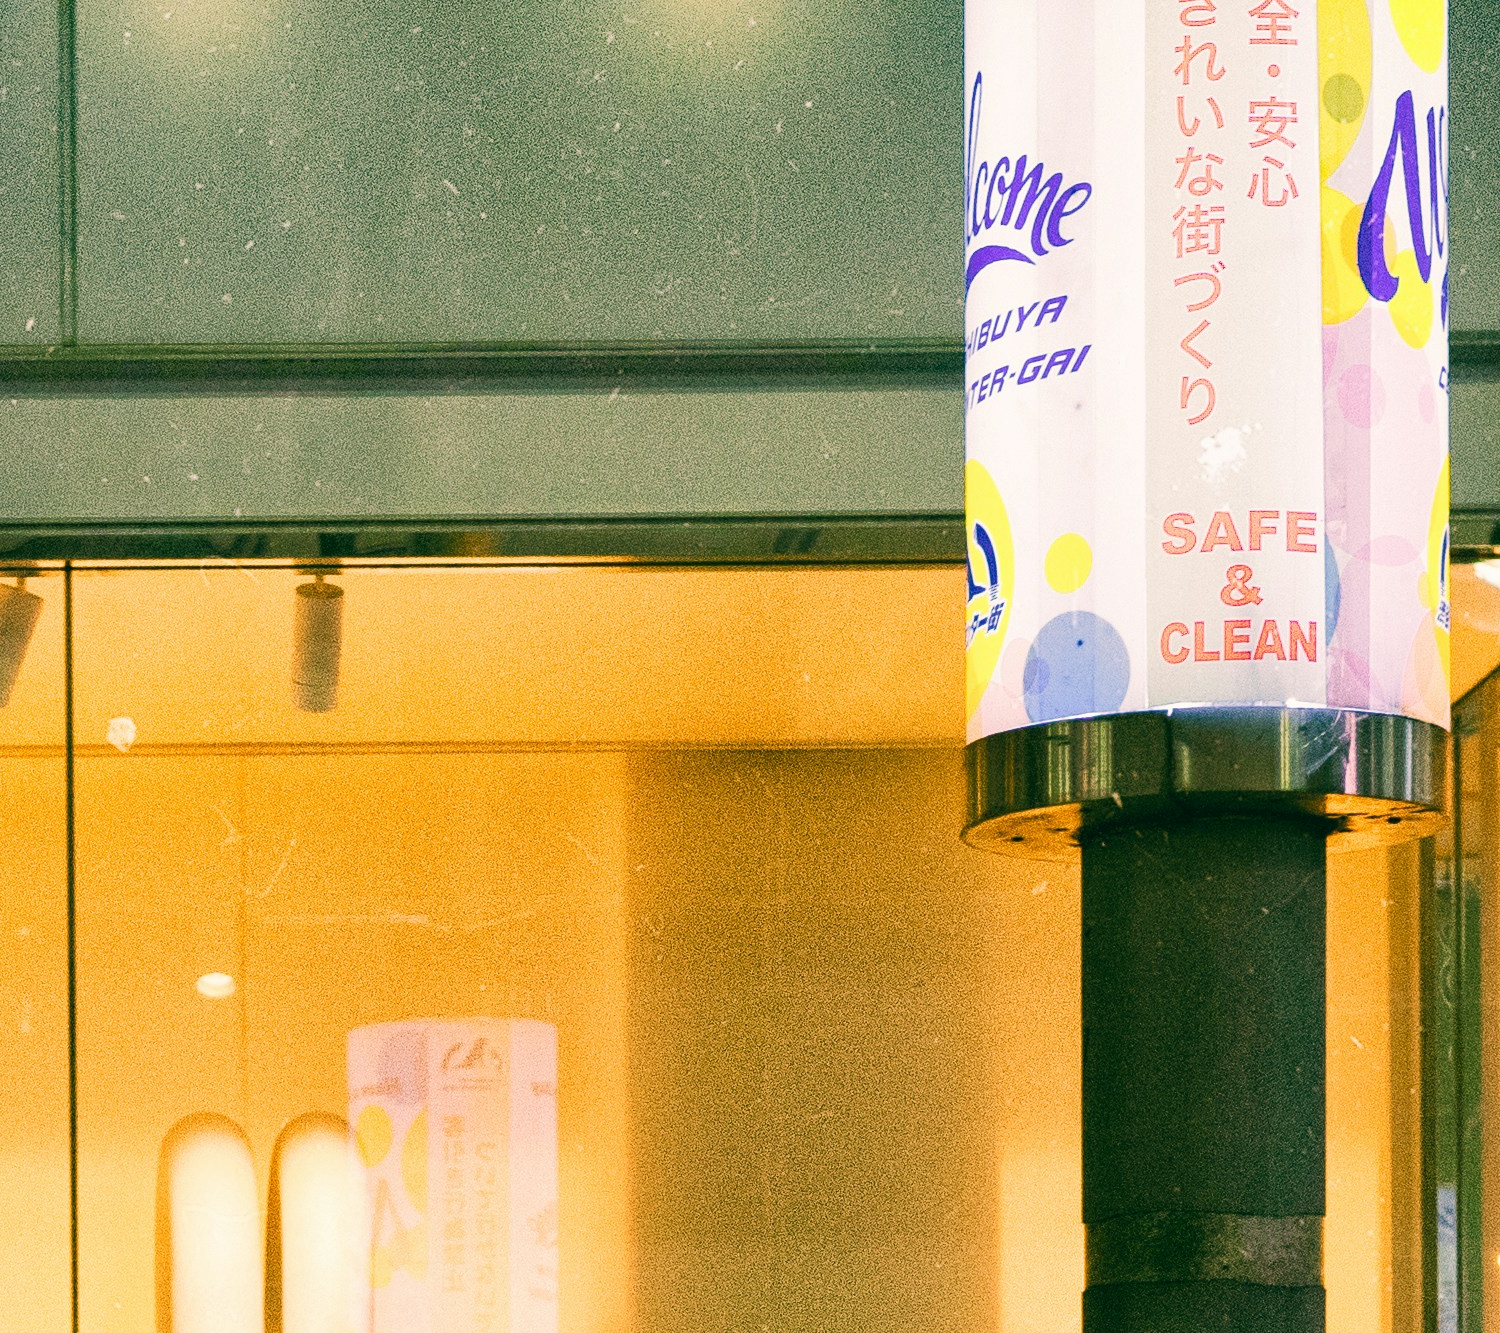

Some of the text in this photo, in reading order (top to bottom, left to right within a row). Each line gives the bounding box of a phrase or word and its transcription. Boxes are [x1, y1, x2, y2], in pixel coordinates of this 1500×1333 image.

[966, 71, 1092, 257] lcome
[966, 294, 1068, 358] HIBUYA
[965, 344, 1092, 410] TER-GAI
[1162, 510, 1318, 555] SAFE
[1220, 564, 1264, 607] &
[1160, 619, 1318, 665] CLEAN
